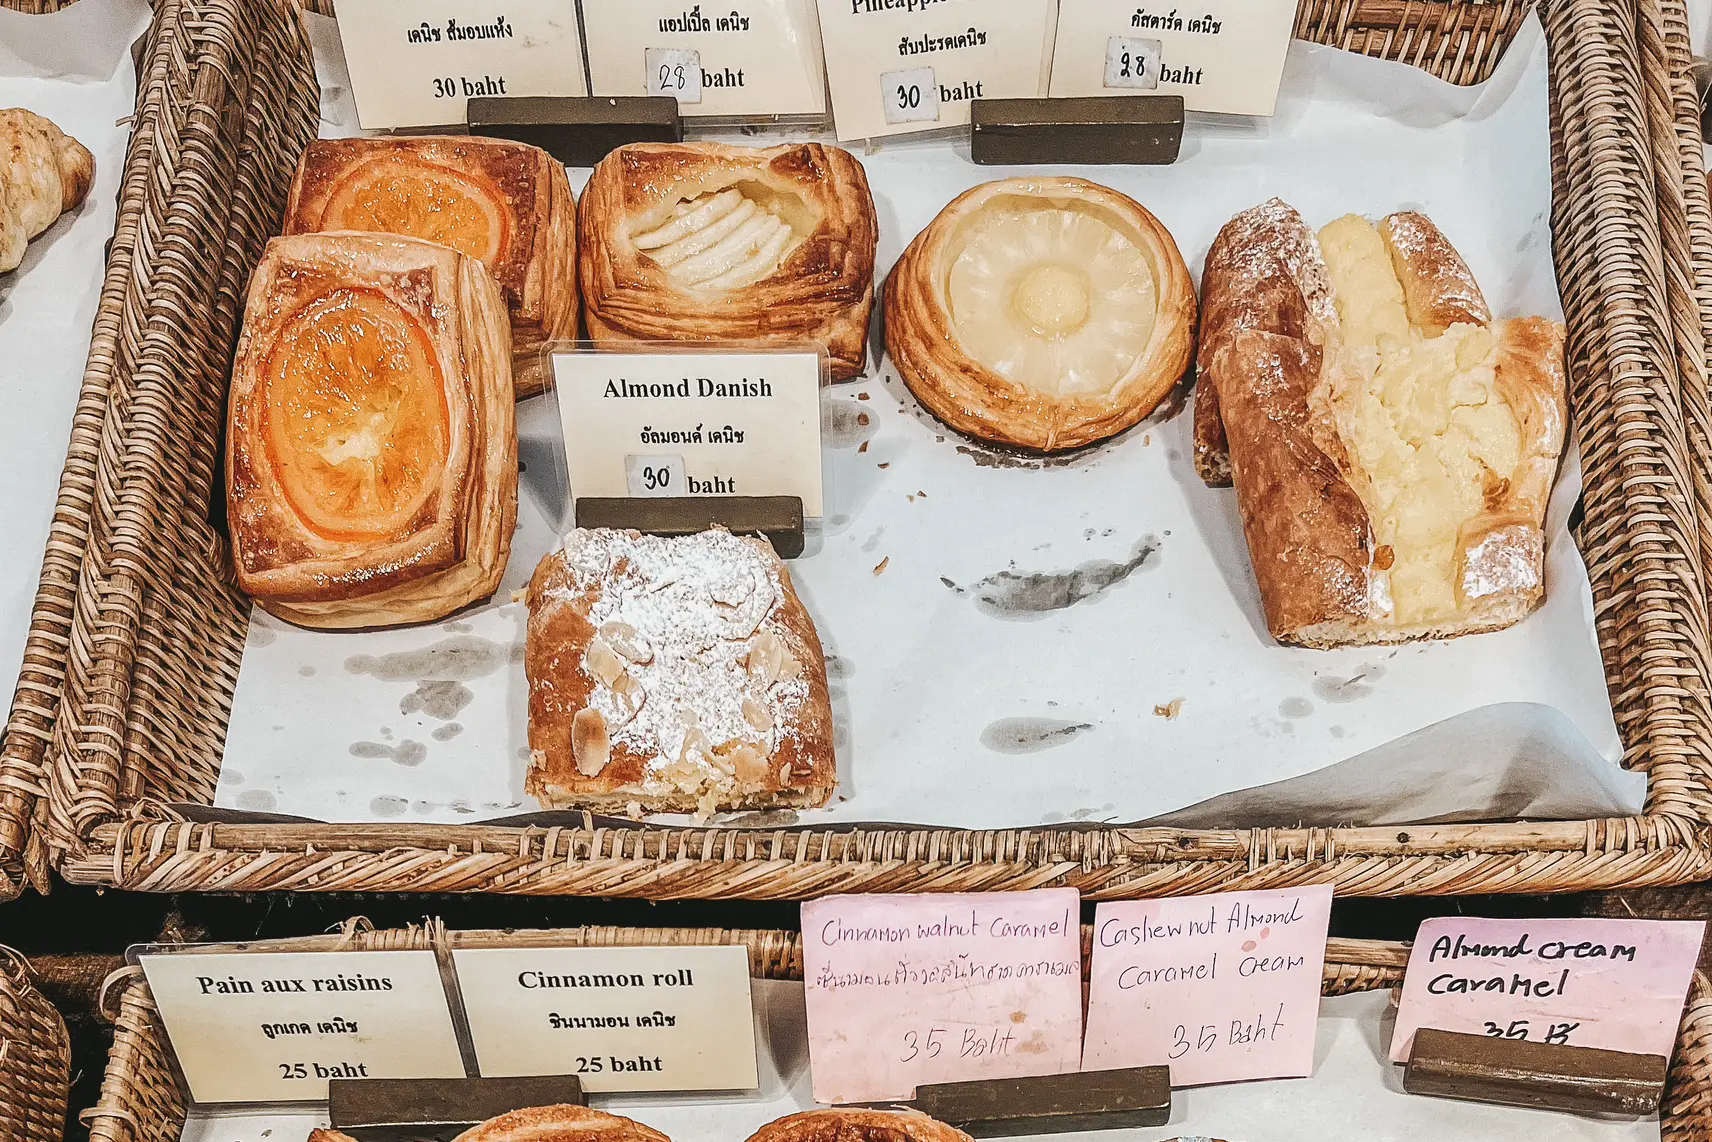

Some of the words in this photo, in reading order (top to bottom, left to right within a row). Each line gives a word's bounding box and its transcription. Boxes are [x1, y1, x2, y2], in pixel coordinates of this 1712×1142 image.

[659, 64, 686, 91] 28
[700, 67, 745, 88] baht
[1120, 52, 1145, 78] 28
[1159, 63, 1204, 85] baht
[432, 77, 456, 99] 30
[460, 75, 507, 97] baht
[896, 85, 921, 109] 30
[938, 80, 984, 104] baht
[603, 378, 691, 398] Almond
[696, 377, 773, 398] Danish
[643, 466, 670, 490] 30
[687, 475, 736, 494] baht
[821, 918, 910, 946] Cinnamon
[917, 909, 979, 939] walnut
[989, 908, 1069, 938] Caramel
[1100, 915, 1182, 948] Cashew
[1188, 906, 1217, 937] nut
[1227, 897, 1304, 933] Almond
[1429, 933, 1534, 963] Almond
[196, 976, 255, 995] Pain
[261, 979, 307, 993] aux
[311, 973, 393, 992] raisins
[518, 971, 645, 989] Cinnamon
[652, 969, 694, 987] roll
[1118, 952, 1217, 990] Caramel
[900, 1028, 946, 1063] 35
[1168, 1024, 1217, 1060] 35
[278, 1062, 308, 1080] 25
[311, 1062, 369, 1079] baht
[575, 1056, 603, 1073] 25
[609, 1055, 663, 1073] baht
